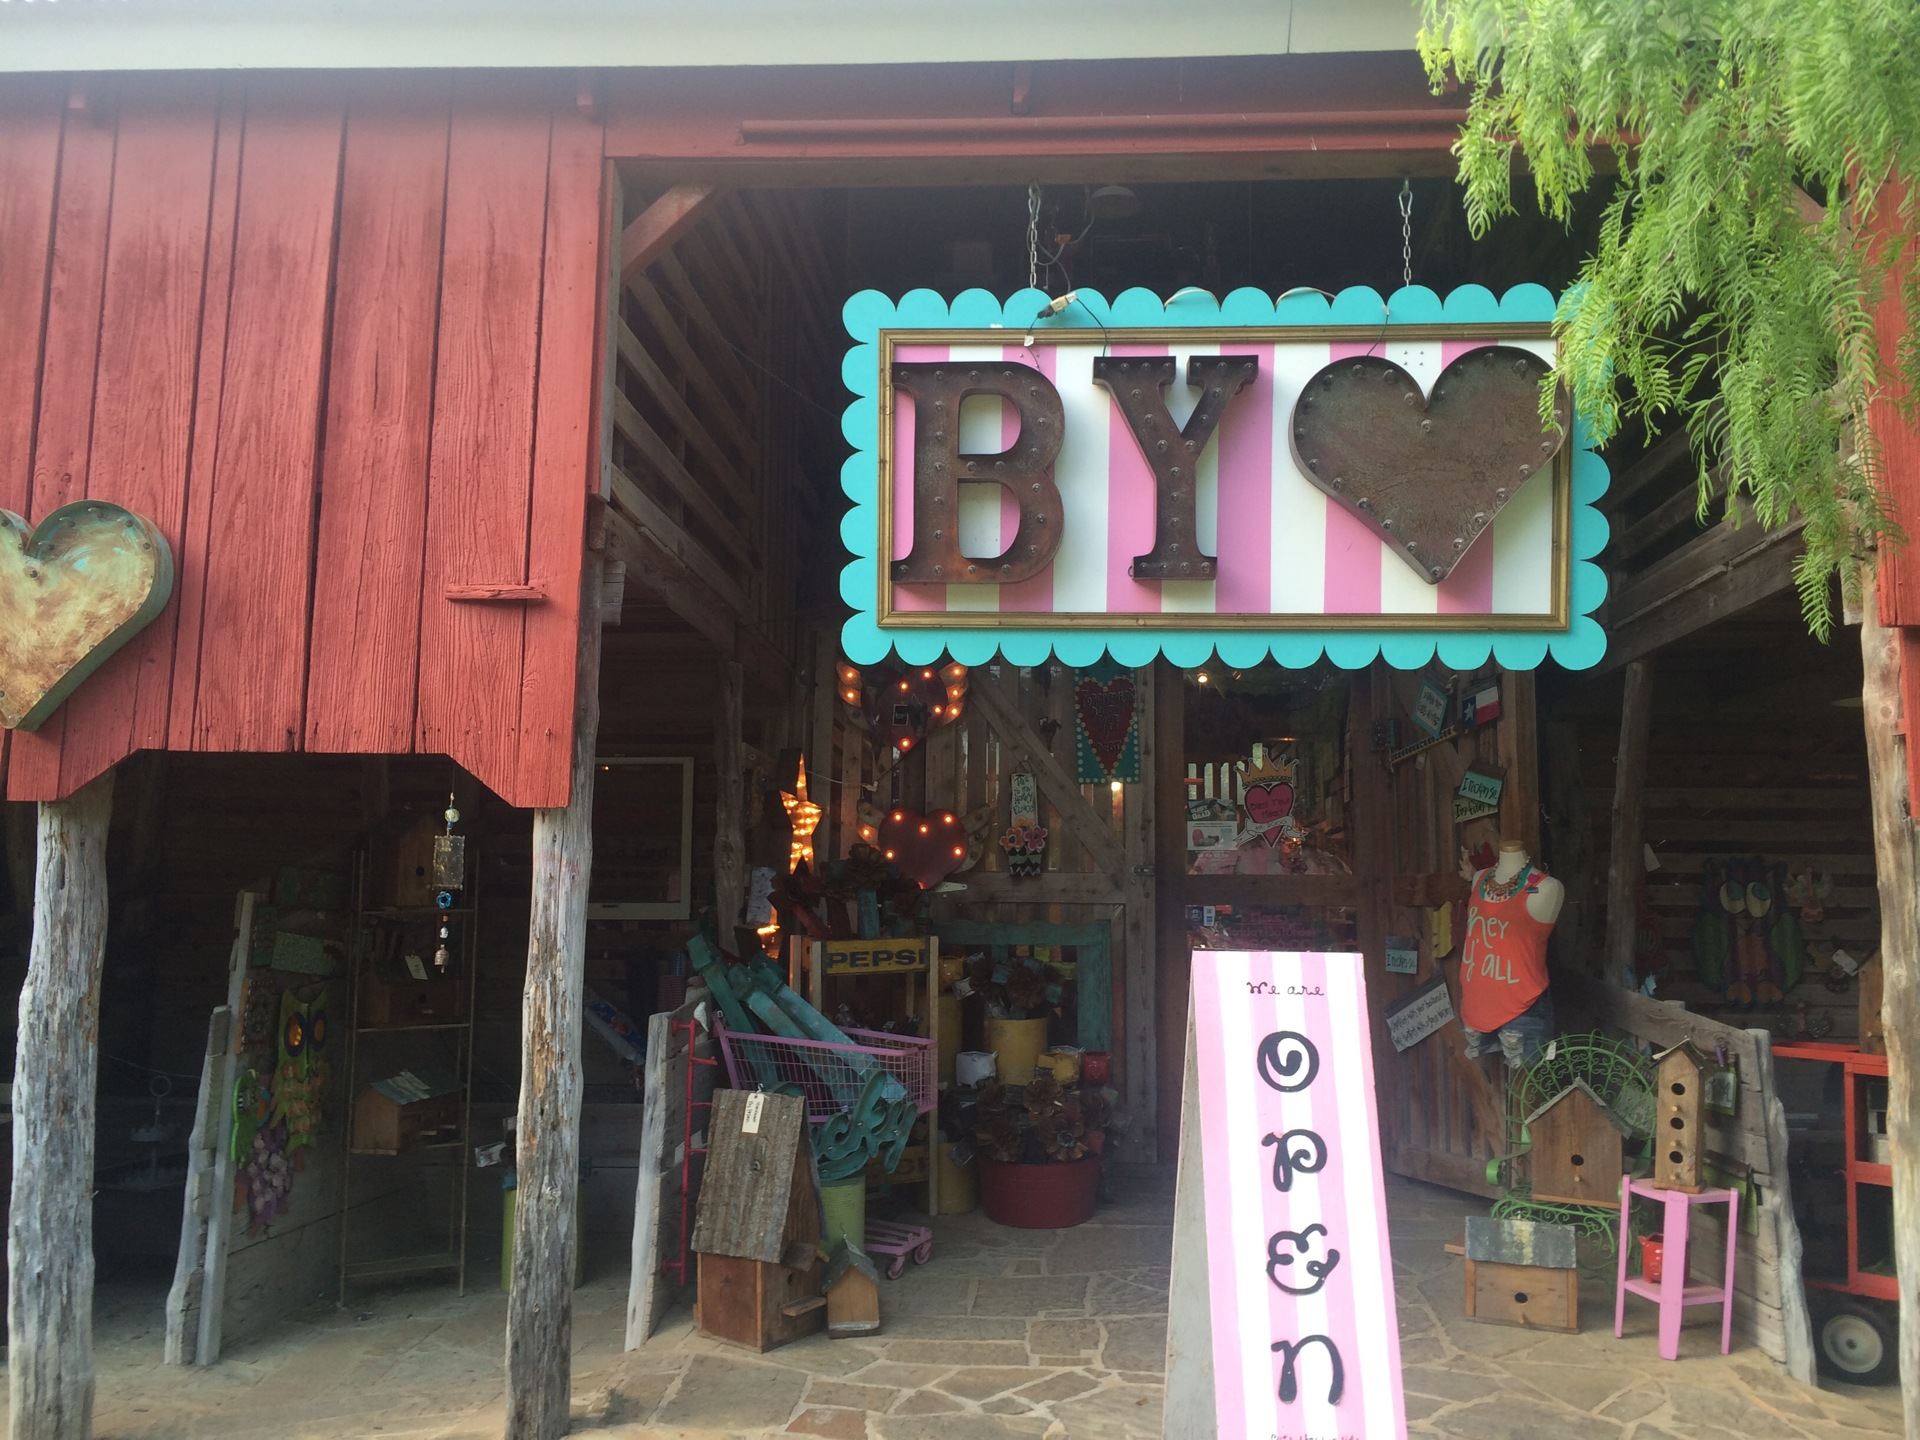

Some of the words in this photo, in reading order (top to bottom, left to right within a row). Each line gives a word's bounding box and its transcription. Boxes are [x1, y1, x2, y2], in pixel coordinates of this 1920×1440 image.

[890, 355, 1259, 585] BY
[825, 948, 929, 969] PEPSI
[1246, 981, 1280, 995] We
[1287, 985, 1325, 996] are
